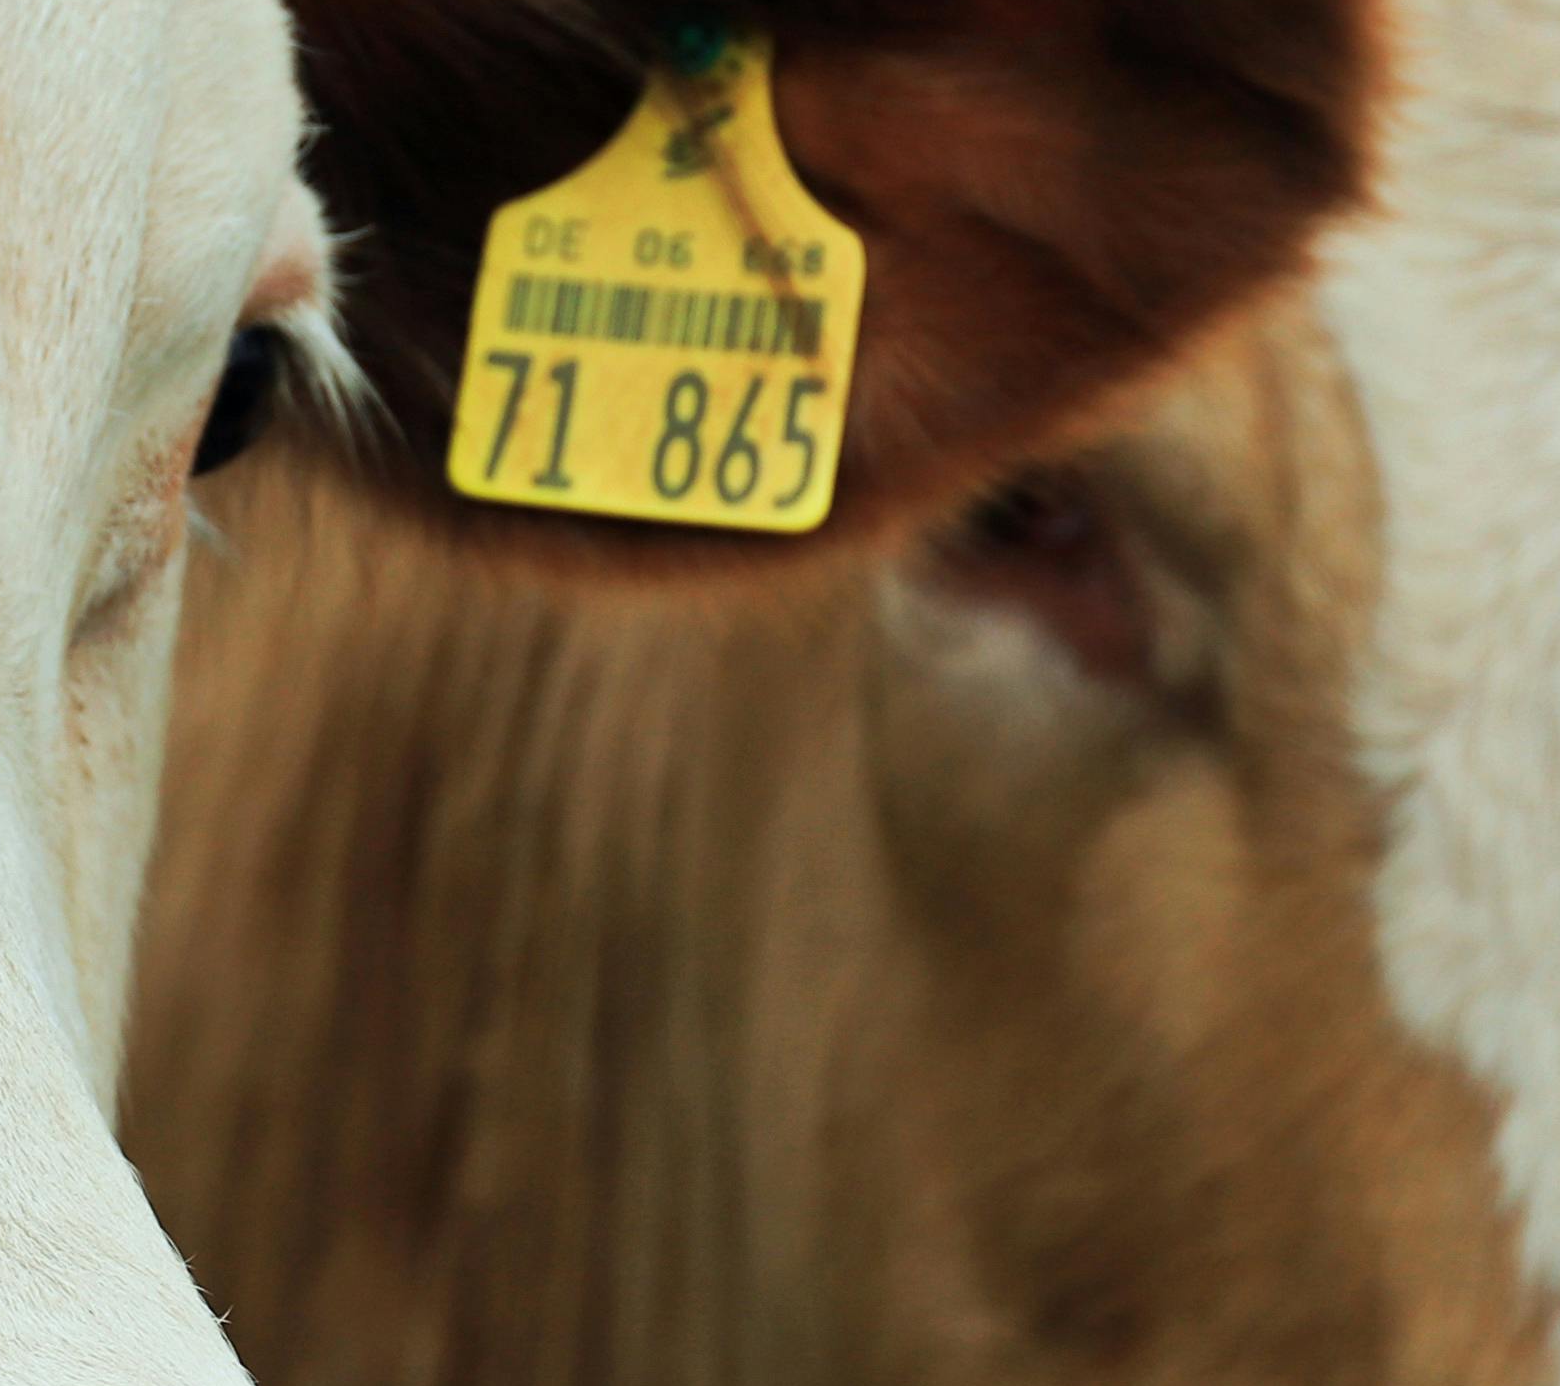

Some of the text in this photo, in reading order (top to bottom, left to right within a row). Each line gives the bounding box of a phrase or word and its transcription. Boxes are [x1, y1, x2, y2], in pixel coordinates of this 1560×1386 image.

[523, 215, 591, 262] DE
[633, 227, 694, 271] 06
[484, 349, 826, 509] 71 865
